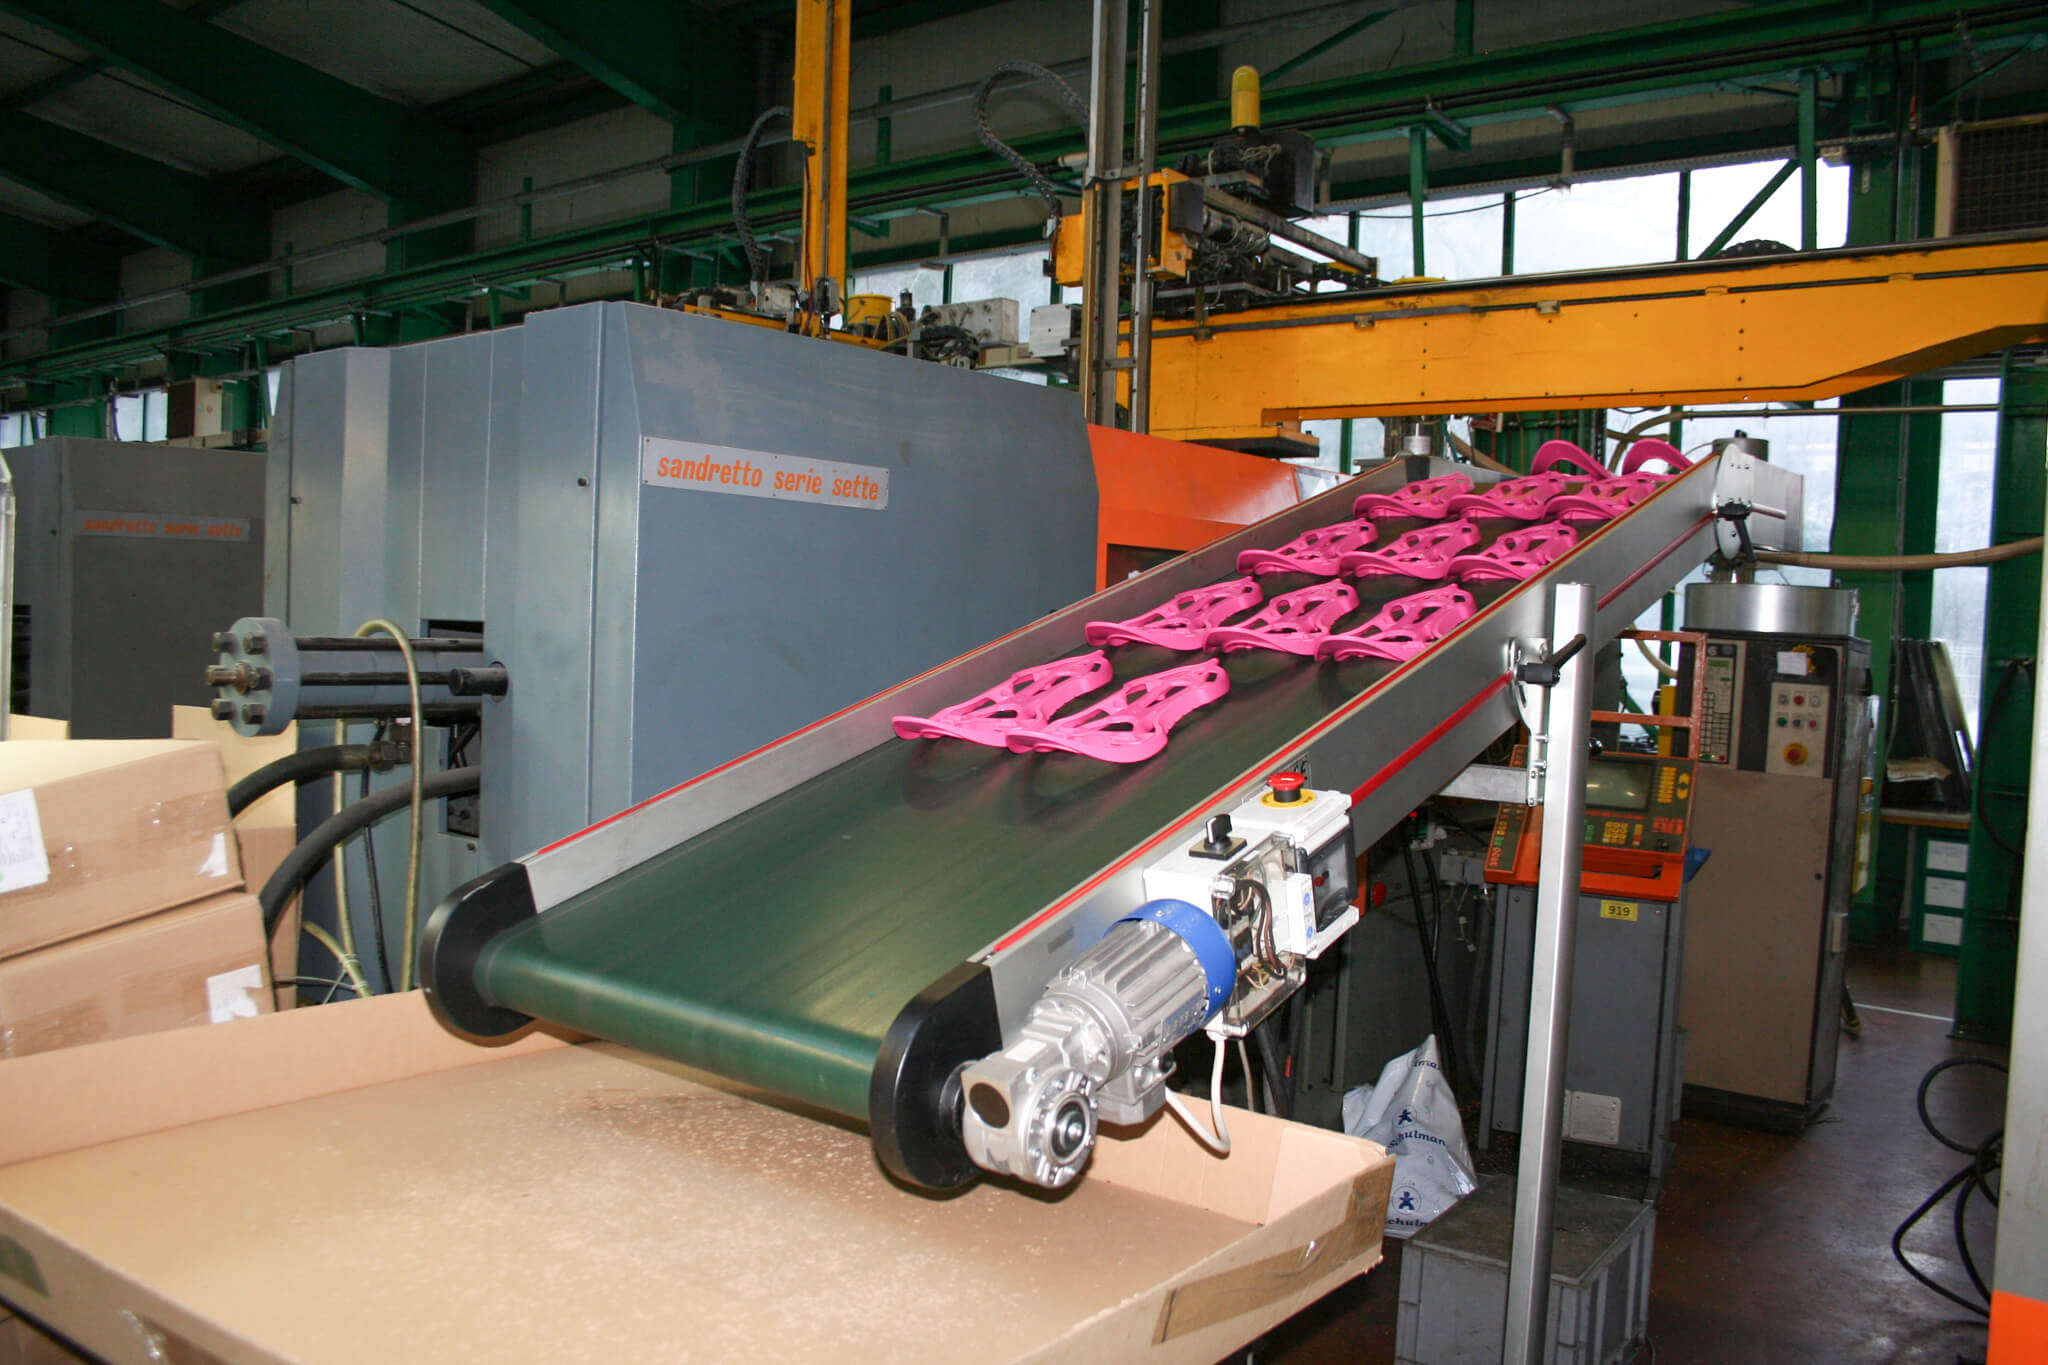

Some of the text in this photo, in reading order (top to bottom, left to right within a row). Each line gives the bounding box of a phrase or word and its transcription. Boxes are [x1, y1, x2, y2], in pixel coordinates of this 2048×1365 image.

[657, 454, 880, 501] sandretto serie sette
[1608, 905, 1630, 916] 919
